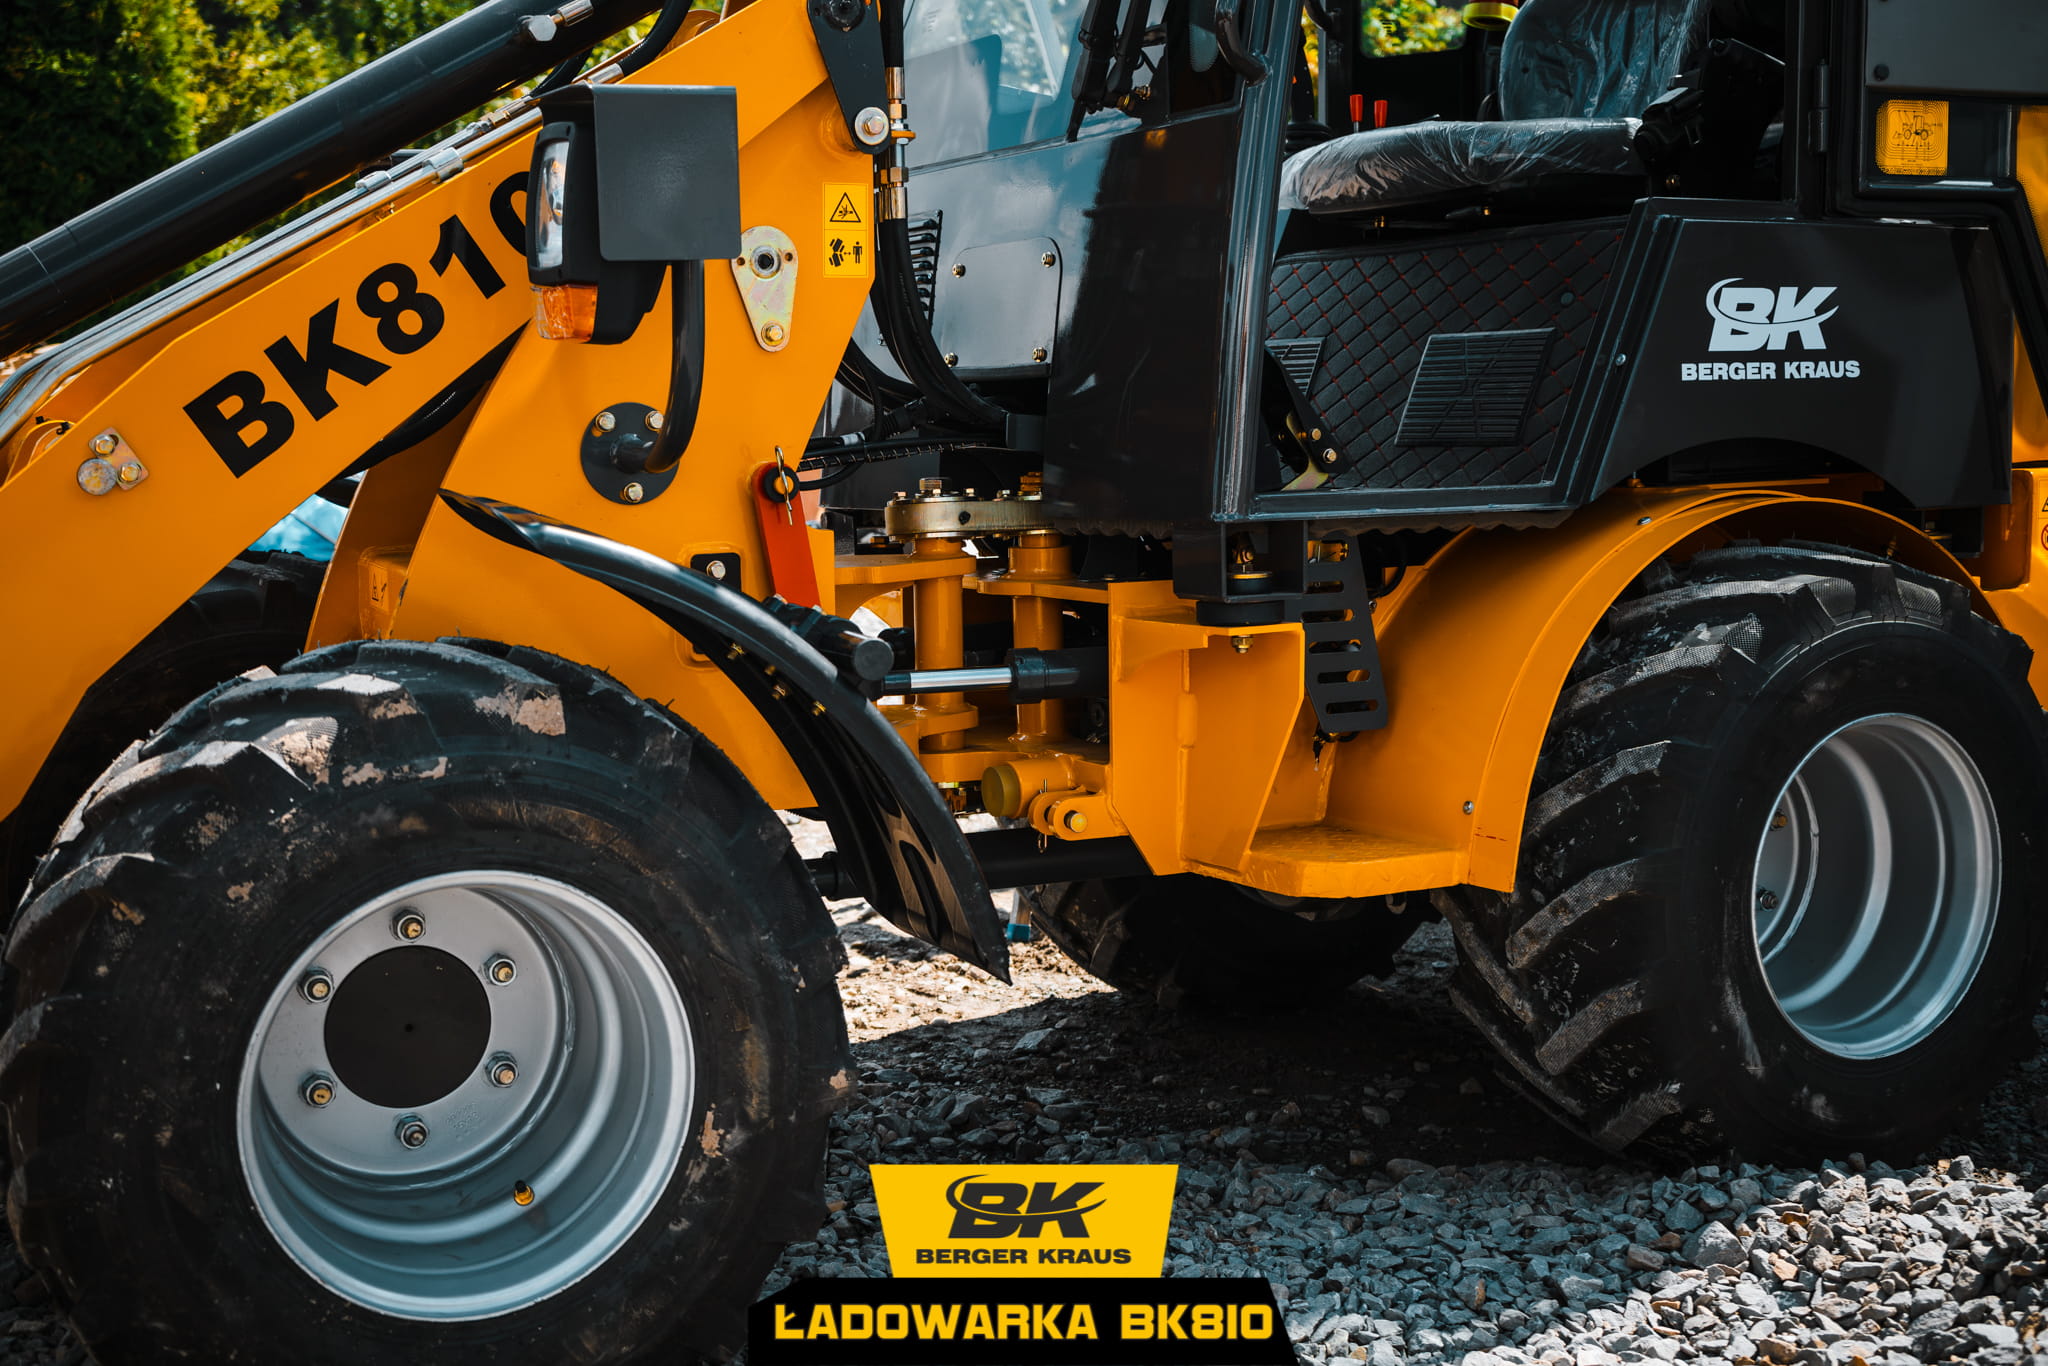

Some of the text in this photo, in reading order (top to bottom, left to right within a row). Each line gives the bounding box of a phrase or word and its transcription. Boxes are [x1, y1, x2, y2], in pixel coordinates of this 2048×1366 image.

[1706, 277, 1839, 351] BK
[1681, 360, 1861, 381] BERGER KRAUS
